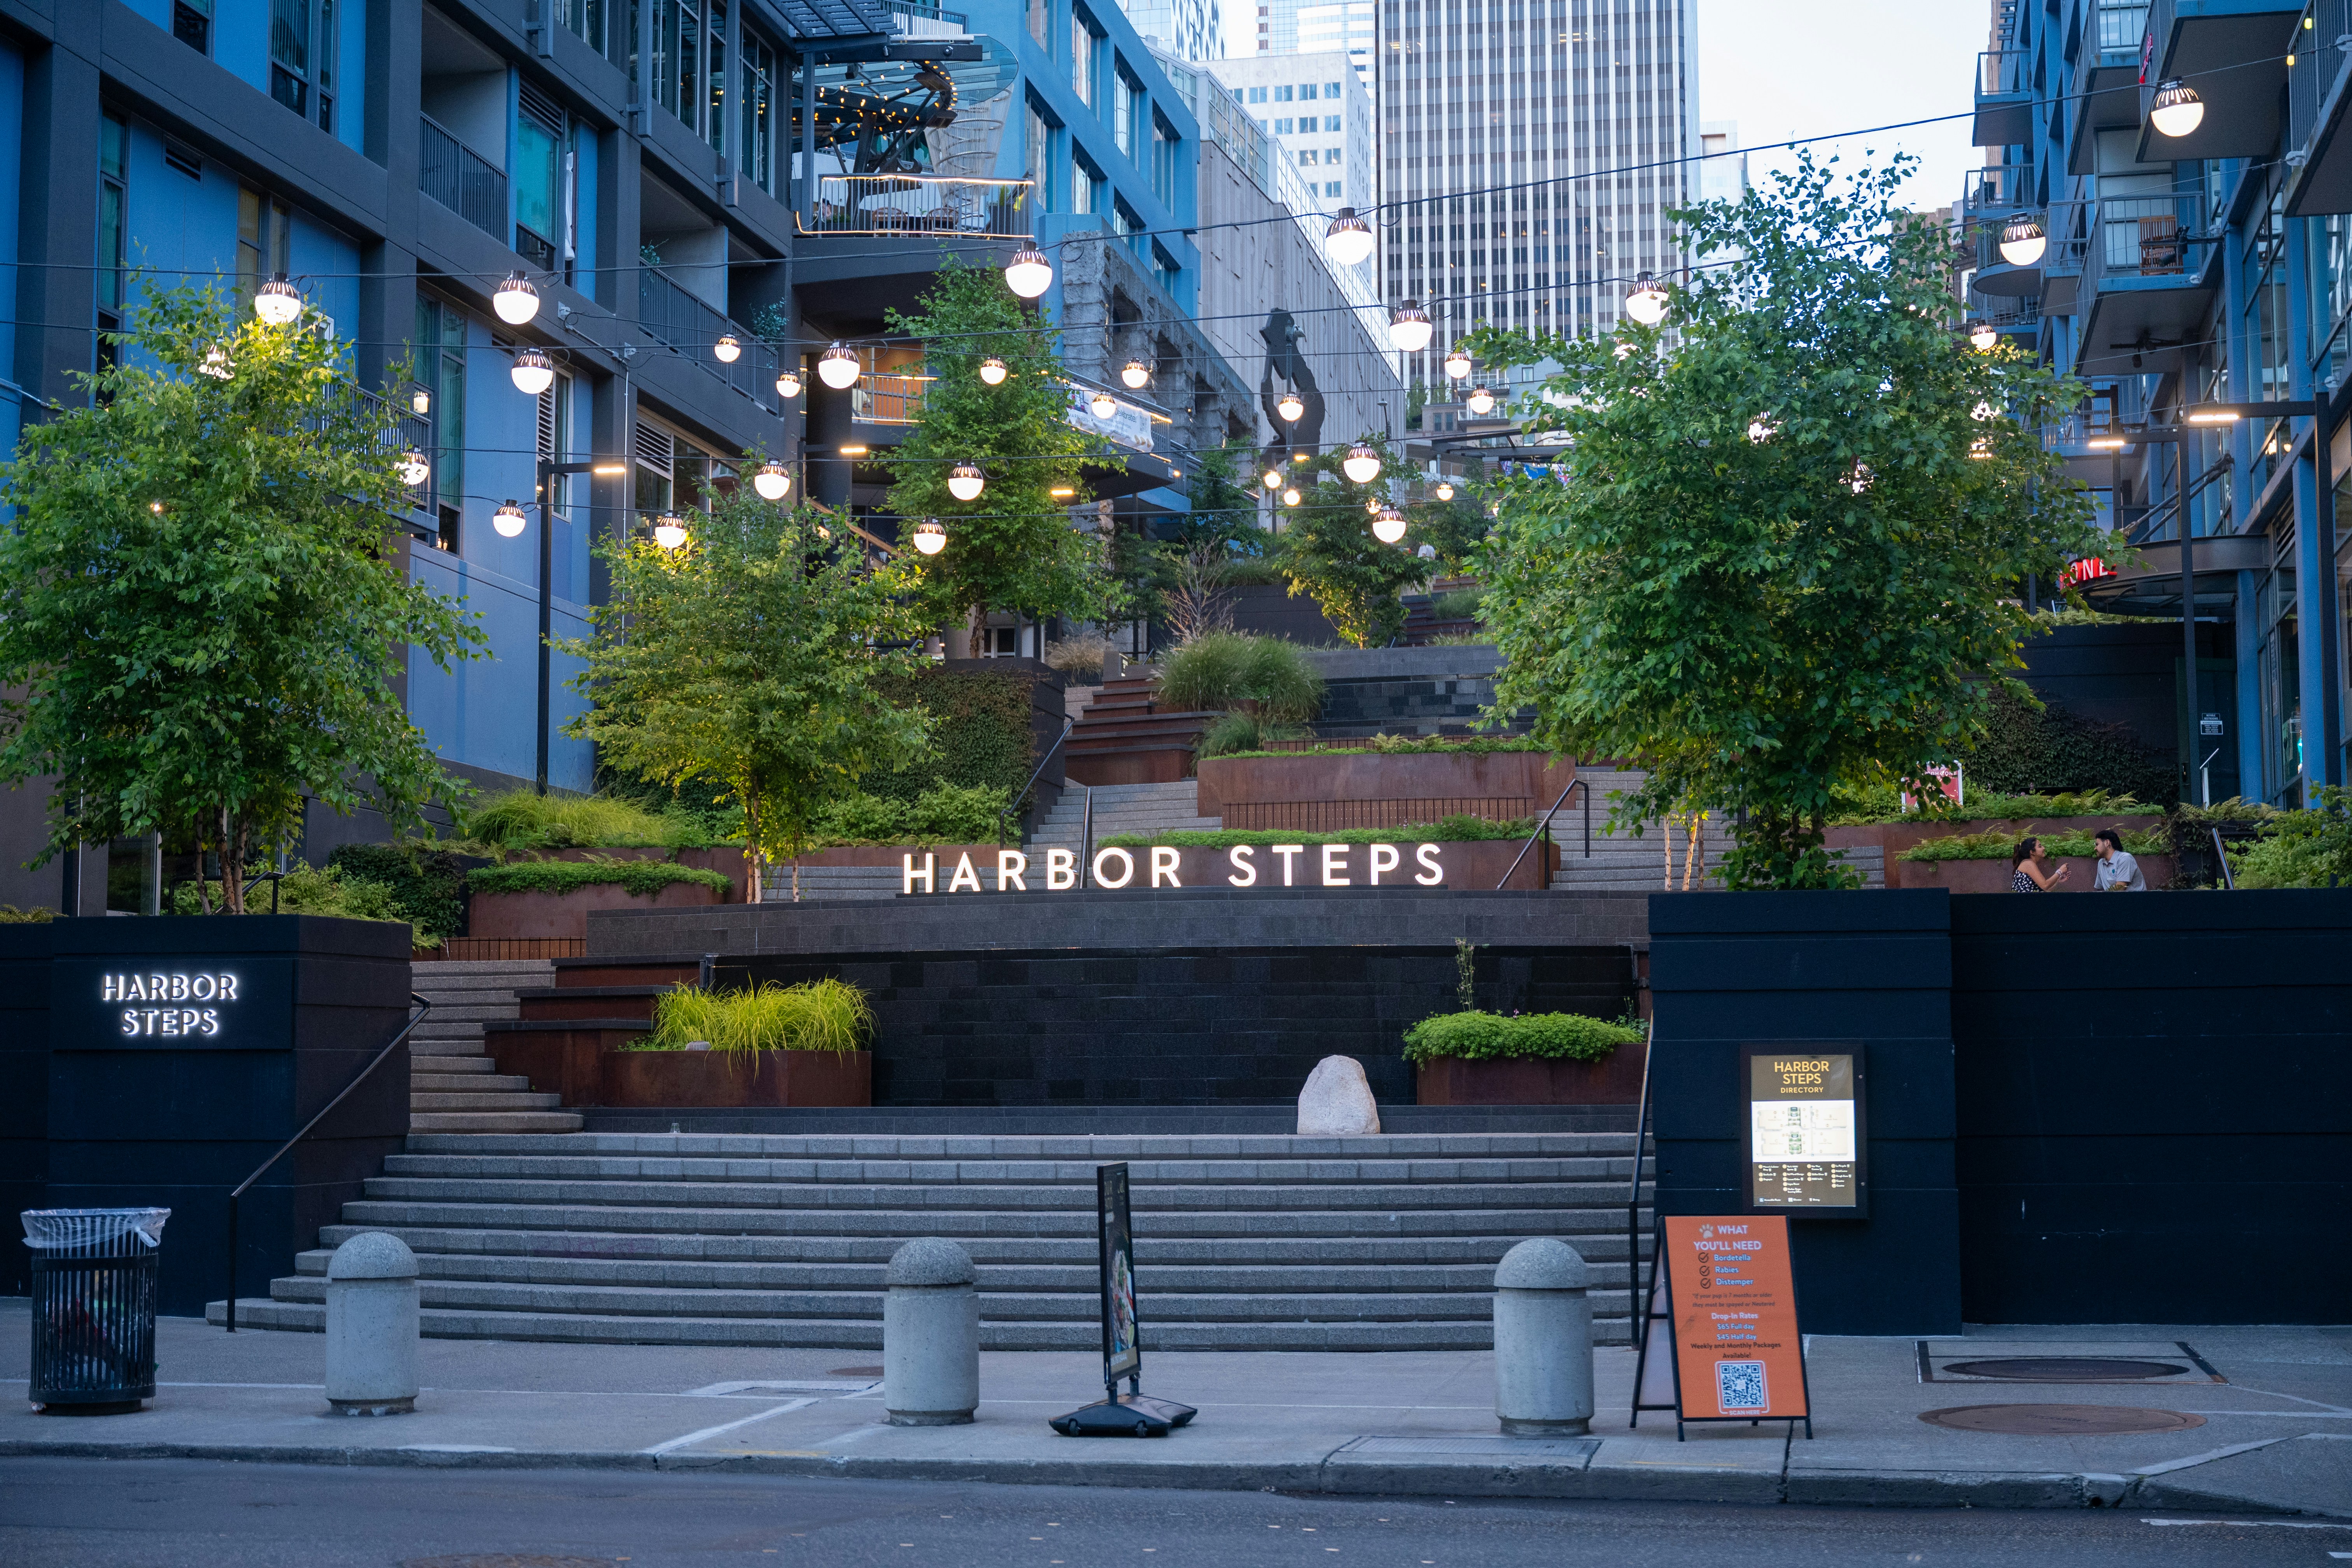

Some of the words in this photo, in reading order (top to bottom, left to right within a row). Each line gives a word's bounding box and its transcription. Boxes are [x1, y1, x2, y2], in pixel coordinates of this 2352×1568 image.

[902, 847, 1181, 894] HARBOR
[1228, 843, 1444, 887] STEPS
[102, 974, 238, 1000] HARBOR
[122, 1009, 219, 1035] STEPS
[1774, 1061, 1829, 1072] HARBOR
[1783, 1073, 1822, 1084] STEPS
[1717, 1225, 1748, 1234] WHAT
[1694, 1241, 1731, 1251] YOU'LL
[1732, 1241, 1762, 1250] NEED
[1715, 1278, 1754, 1286] Distemper
